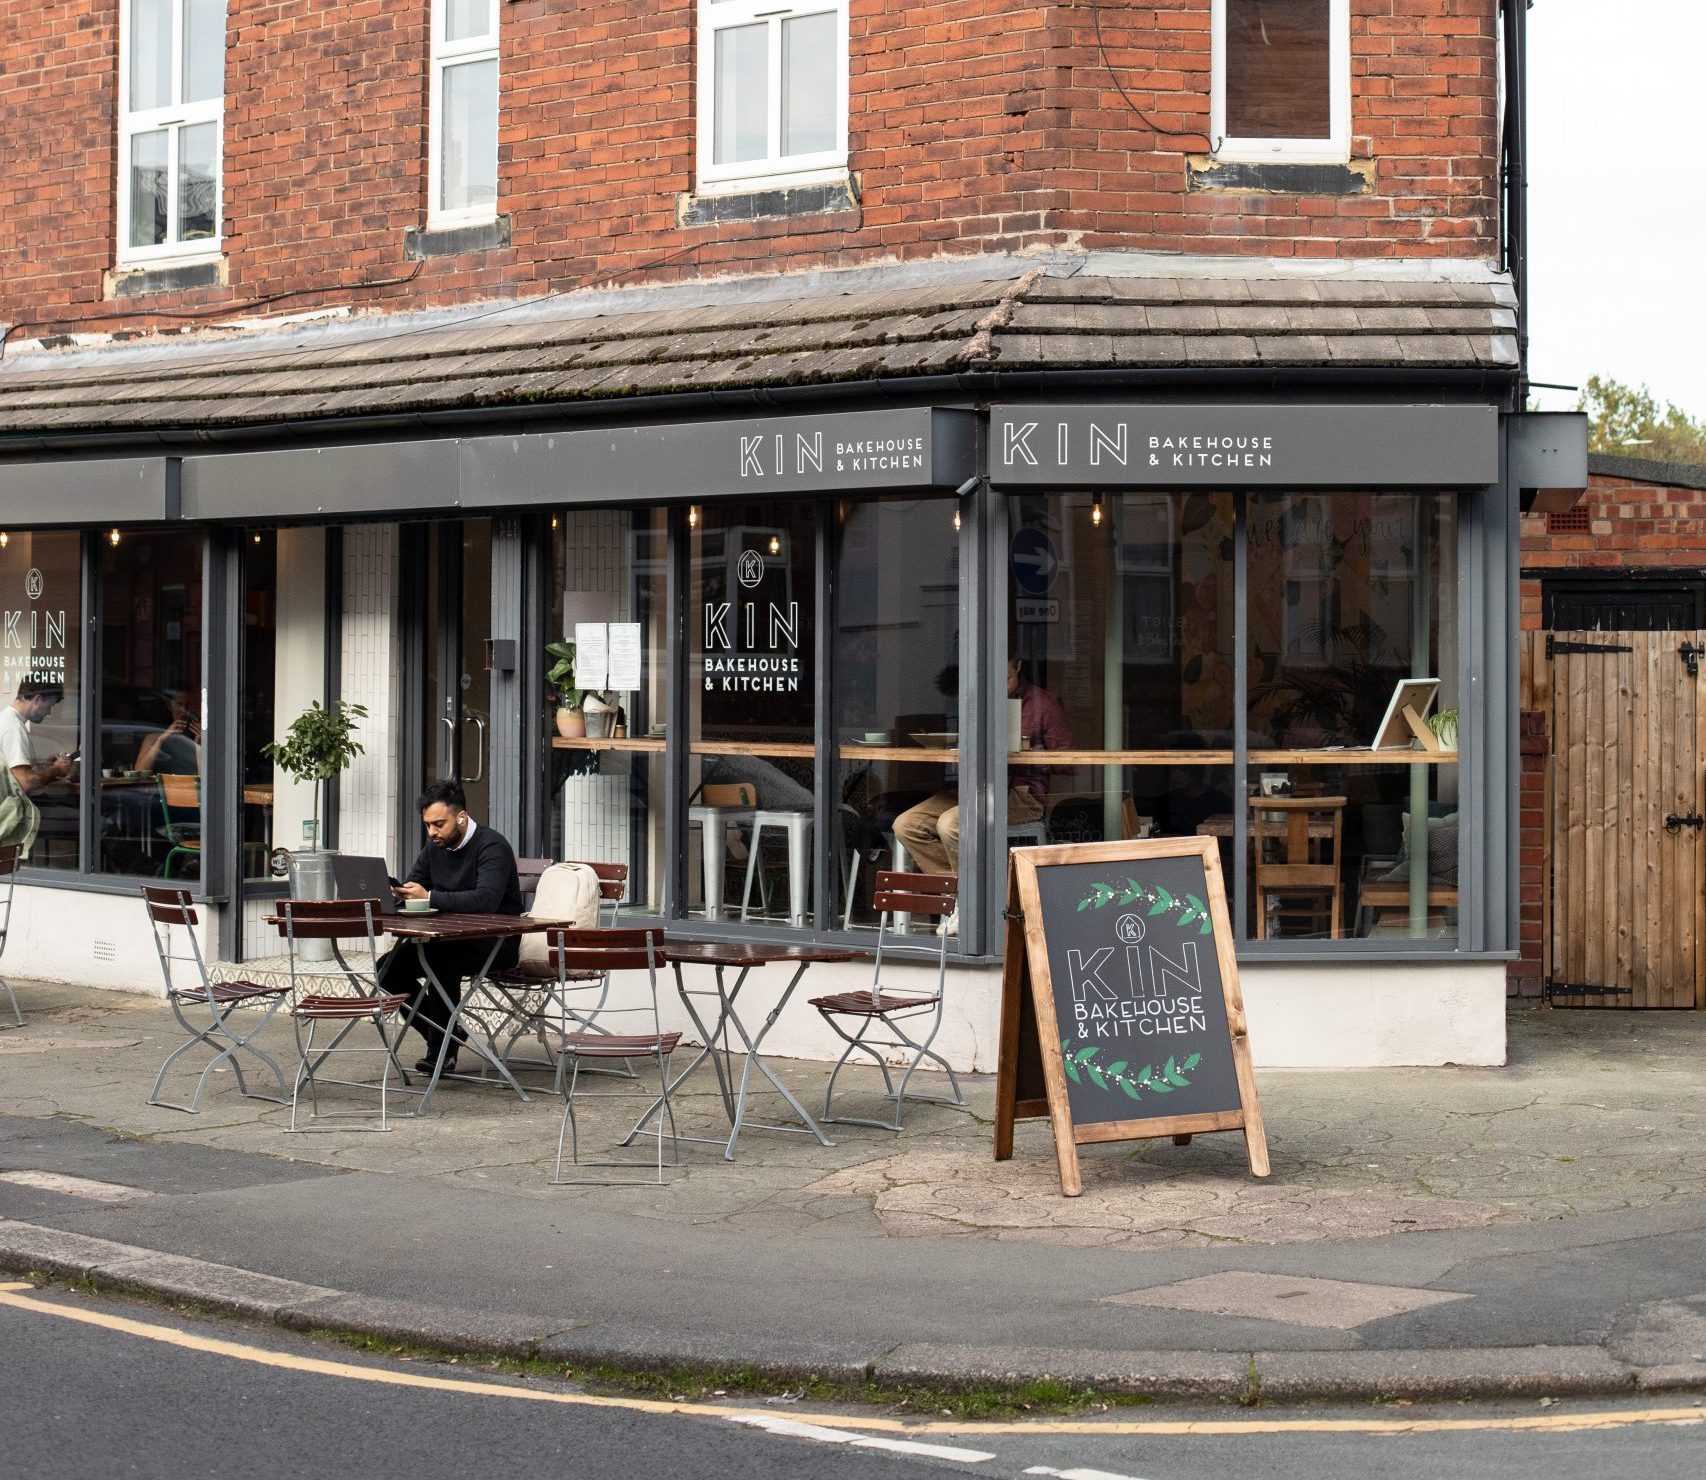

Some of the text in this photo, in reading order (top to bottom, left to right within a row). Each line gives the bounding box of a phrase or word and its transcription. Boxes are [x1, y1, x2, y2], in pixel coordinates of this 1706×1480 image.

[739, 432, 924, 477] KIN BAKEHOUSE
[1004, 422, 1274, 467] KIN BAKEHOUSE
[836, 454, 924, 472] & KITCHEN
[1149, 453, 1273, 467] & KITCHEN
[4, 610, 65, 649] KIN
[705, 602, 798, 649] KIN
[3, 655, 65, 668] BAKEHOUSE
[705, 658, 799, 672] BAKEHOUSE
[16, 671, 65, 684] KITCHEN
[705, 677, 798, 691] & KITCHEN
[1067, 942, 1201, 1001] KIN
[1075, 996, 1204, 1020] BAKEHOUSE
[1078, 1015, 1206, 1038] & KITCHEN
